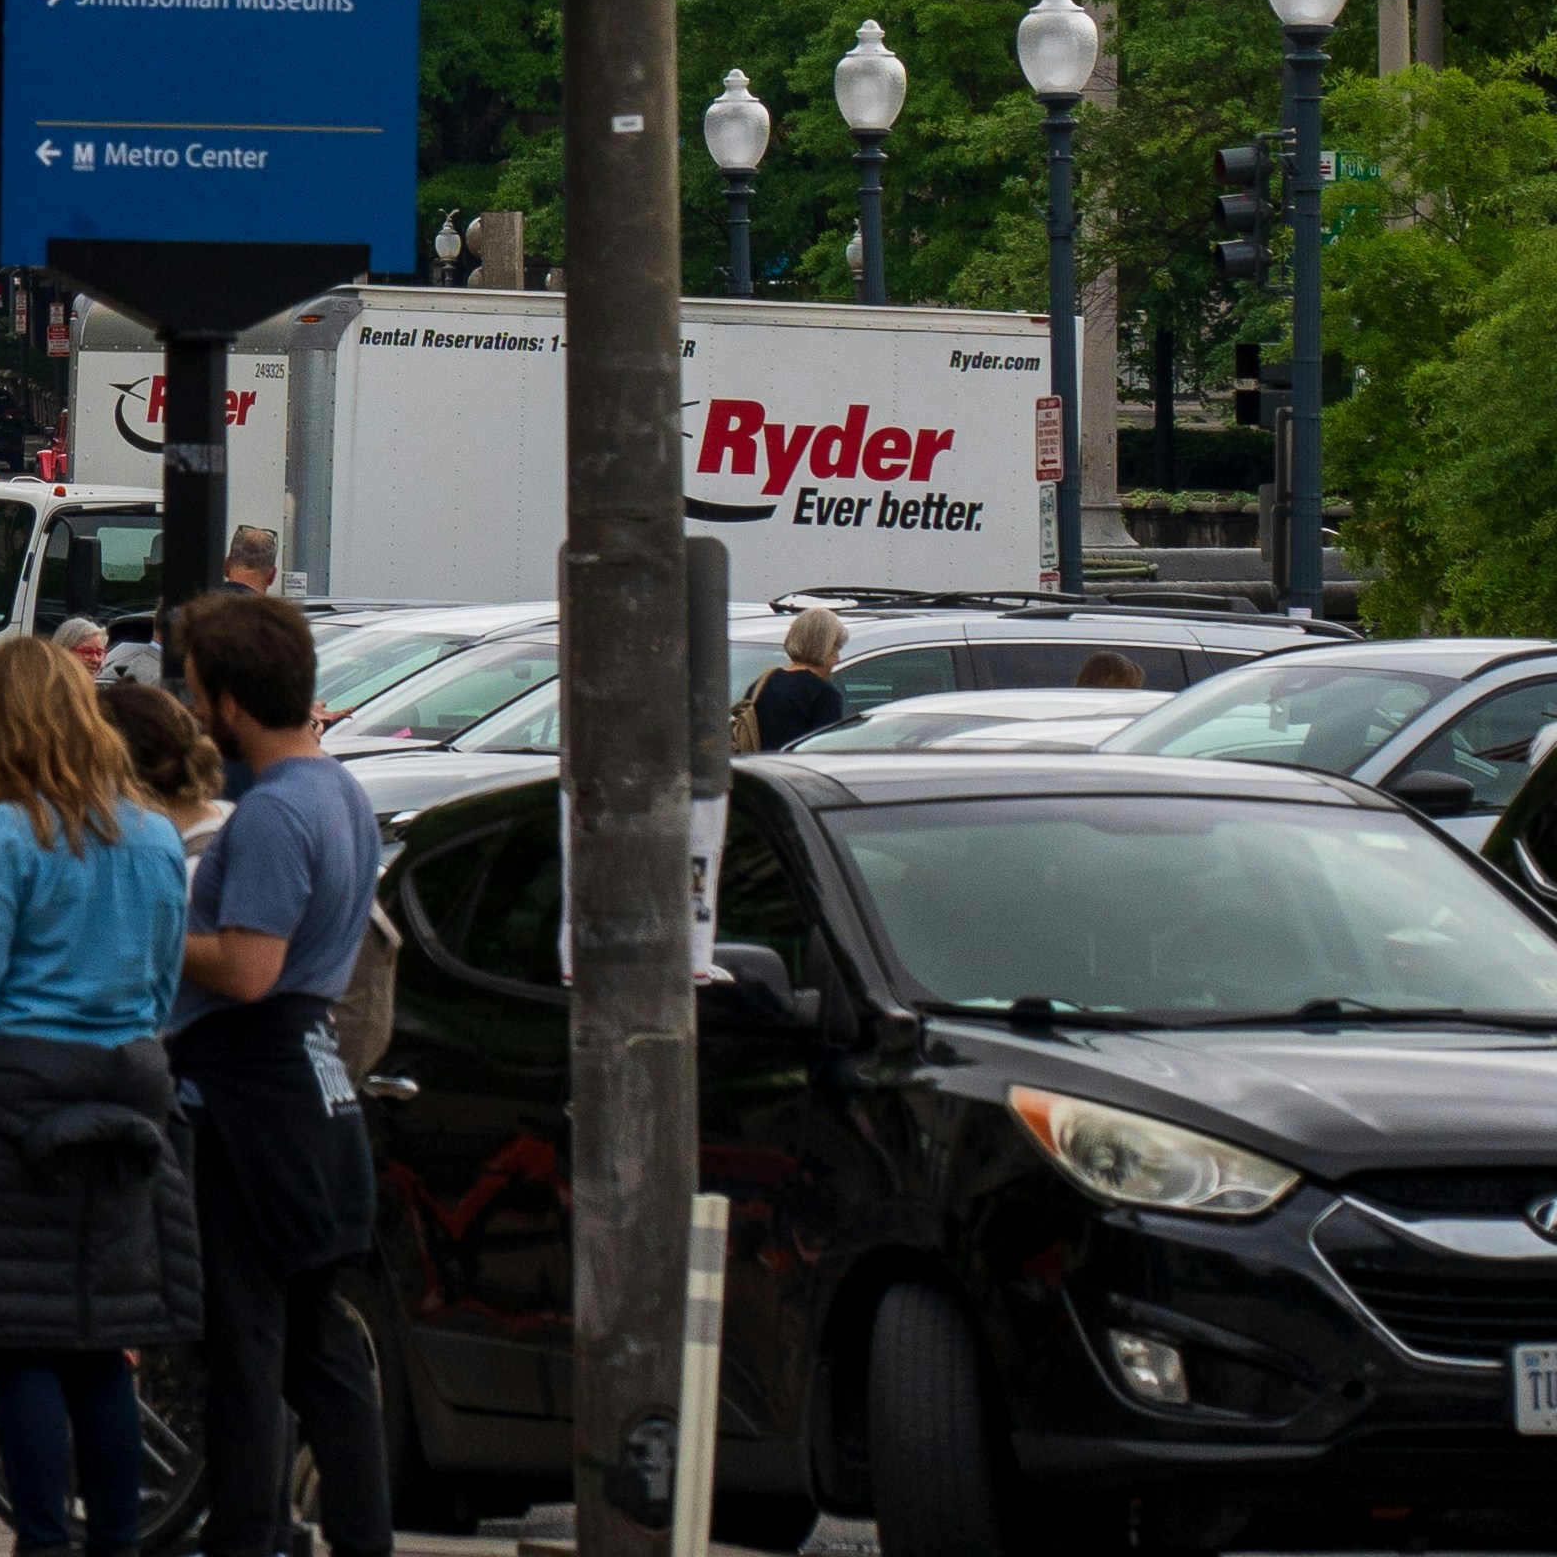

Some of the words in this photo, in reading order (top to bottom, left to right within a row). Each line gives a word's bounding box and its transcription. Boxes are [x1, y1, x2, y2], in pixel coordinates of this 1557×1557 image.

[103, 141, 179, 168] Metro
[185, 143, 268, 170] Center
[360, 326, 416, 348] Rental
[421, 329, 545, 353] Reservations:
[255, 363, 284, 379] 249325
[949, 350, 1040, 372] Ryder.com
[147, 375, 257, 426] Rer
[697, 399, 956, 496] Ryder
[793, 487, 871, 527] Ever
[877, 490, 984, 532] better.
